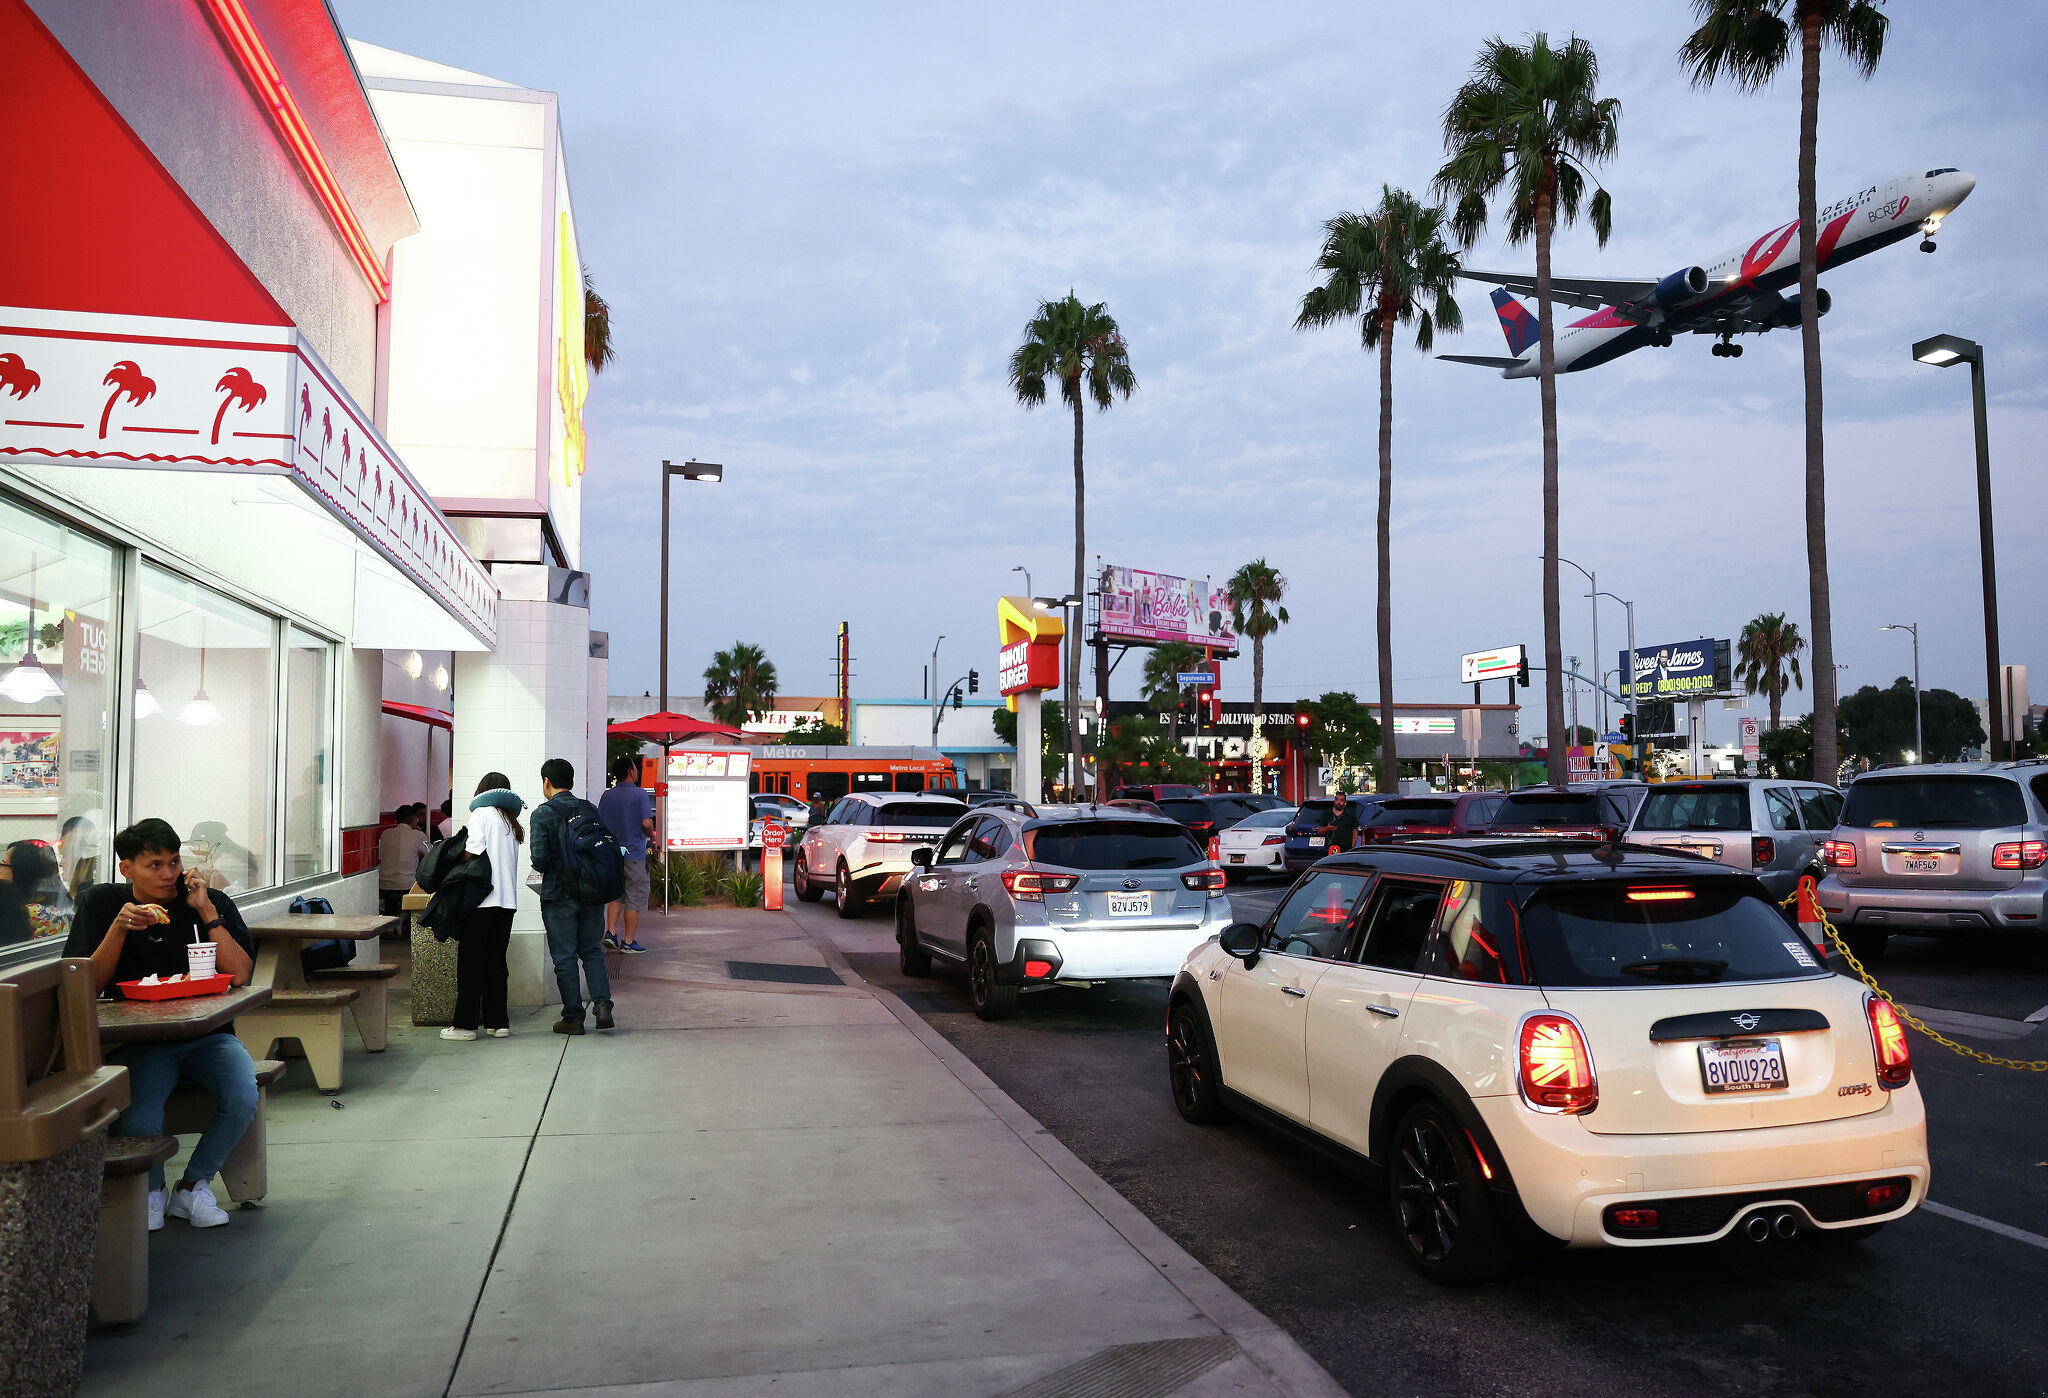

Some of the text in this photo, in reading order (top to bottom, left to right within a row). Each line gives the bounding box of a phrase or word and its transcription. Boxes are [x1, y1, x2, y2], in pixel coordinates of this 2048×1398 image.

[1821, 185, 1877, 217] DELTA
[1867, 202, 1899, 223] BCRF
[1153, 587, 1190, 618] Barbie
[1667, 647, 1703, 667] James
[1000, 663, 1029, 691] BURGER
[1179, 674, 1206, 683] Sepulveda
[1621, 681, 1653, 695] INJRED?
[1216, 712, 1267, 725] HOLLYWOD
[1268, 712, 1295, 725] STARS
[763, 746, 807, 759] Metro
[1904, 860, 1938, 870] 7WAF549
[1111, 901, 1149, 912] 8ZVJ579
[1717, 1047, 1763, 1060] California
[1723, 1082, 1772, 1091] South Bay
